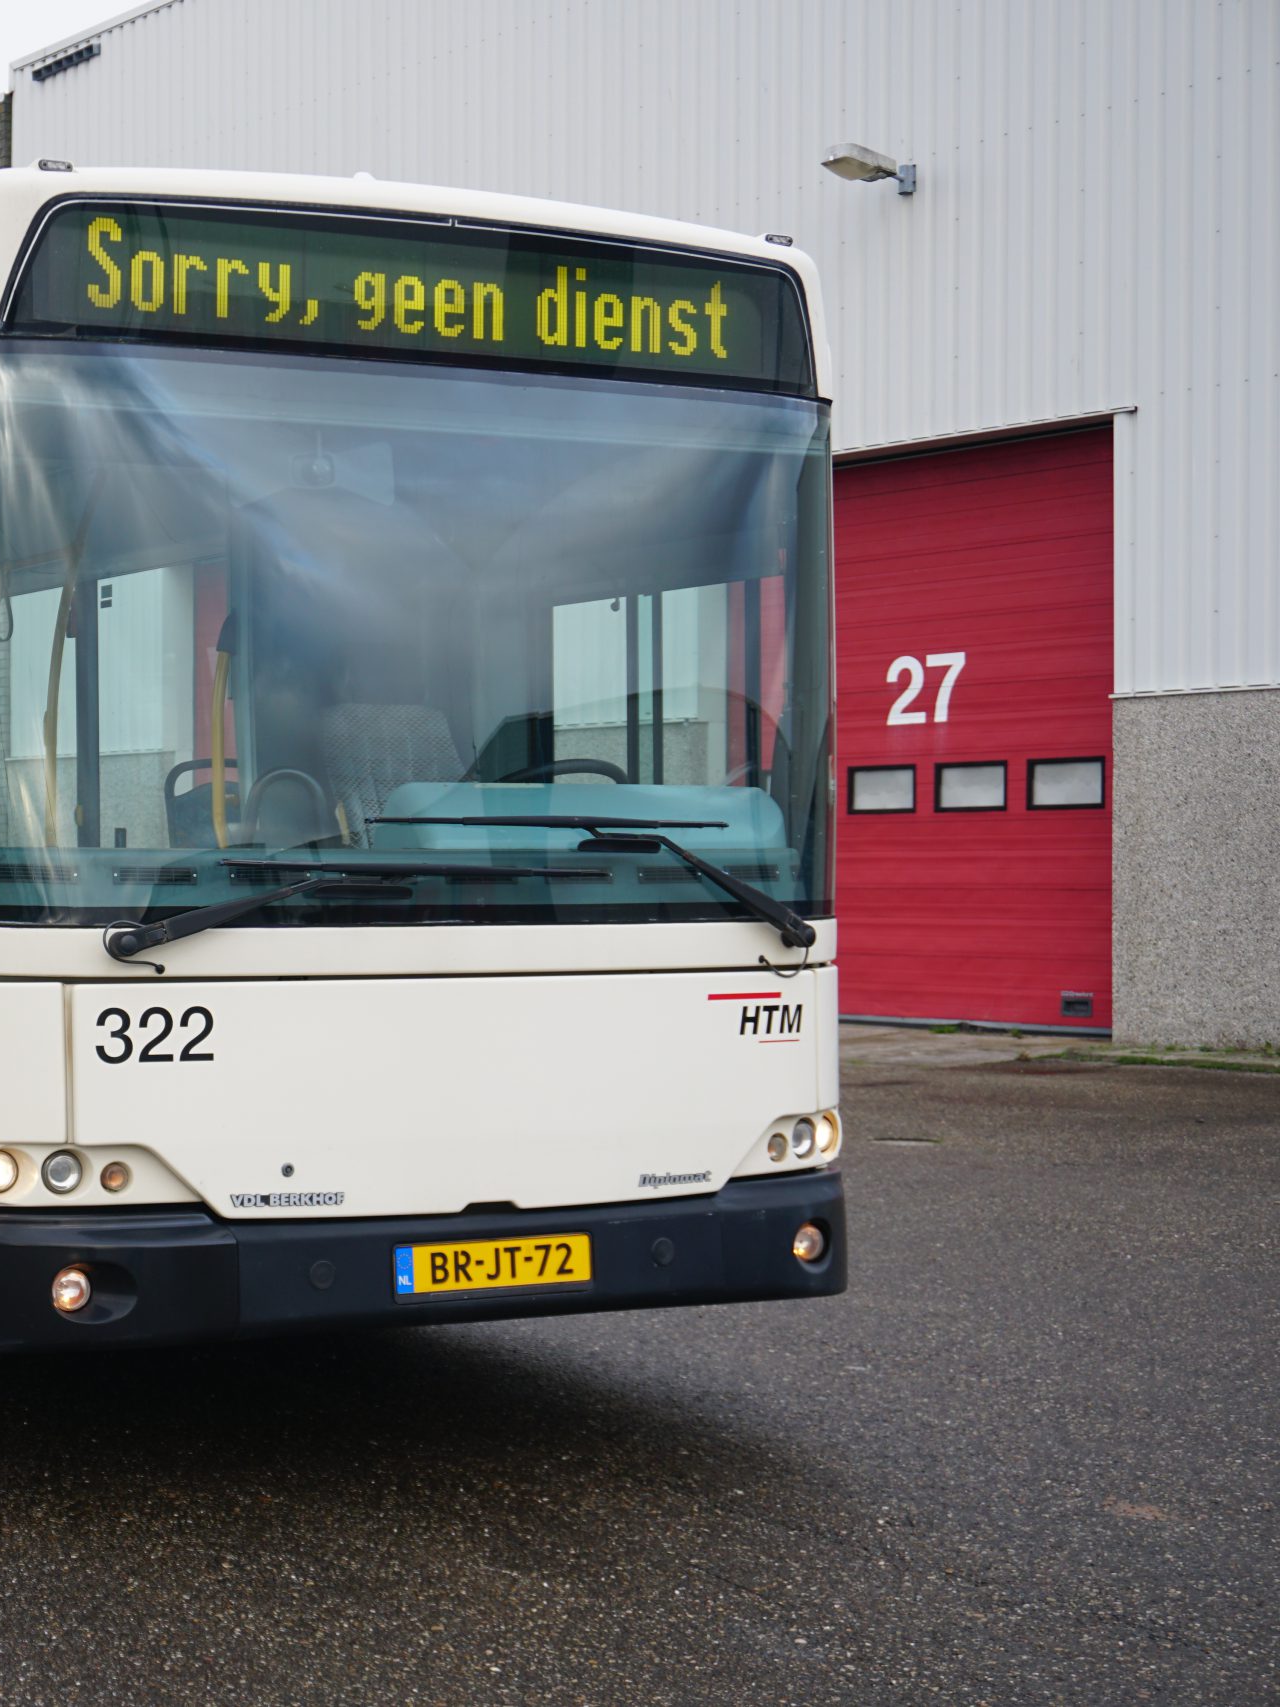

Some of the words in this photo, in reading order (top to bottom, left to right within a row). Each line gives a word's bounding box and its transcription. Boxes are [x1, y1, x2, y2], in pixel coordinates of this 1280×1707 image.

[87, 217, 318, 324] Sorry,
[354, 271, 503, 341] geen
[537, 266, 726, 358] dienst
[886, 652, 966, 726] 27
[96, 1007, 214, 1064] 322
[739, 1004, 803, 1036] HTM
[638, 1170, 712, 1189] Diplomat
[230, 1194, 265, 1207] VDL
[269, 1192, 345, 1207] BERKHOF
[398, 1275, 412, 1286] NL
[430, 1243, 574, 1285] BR-JT-72
